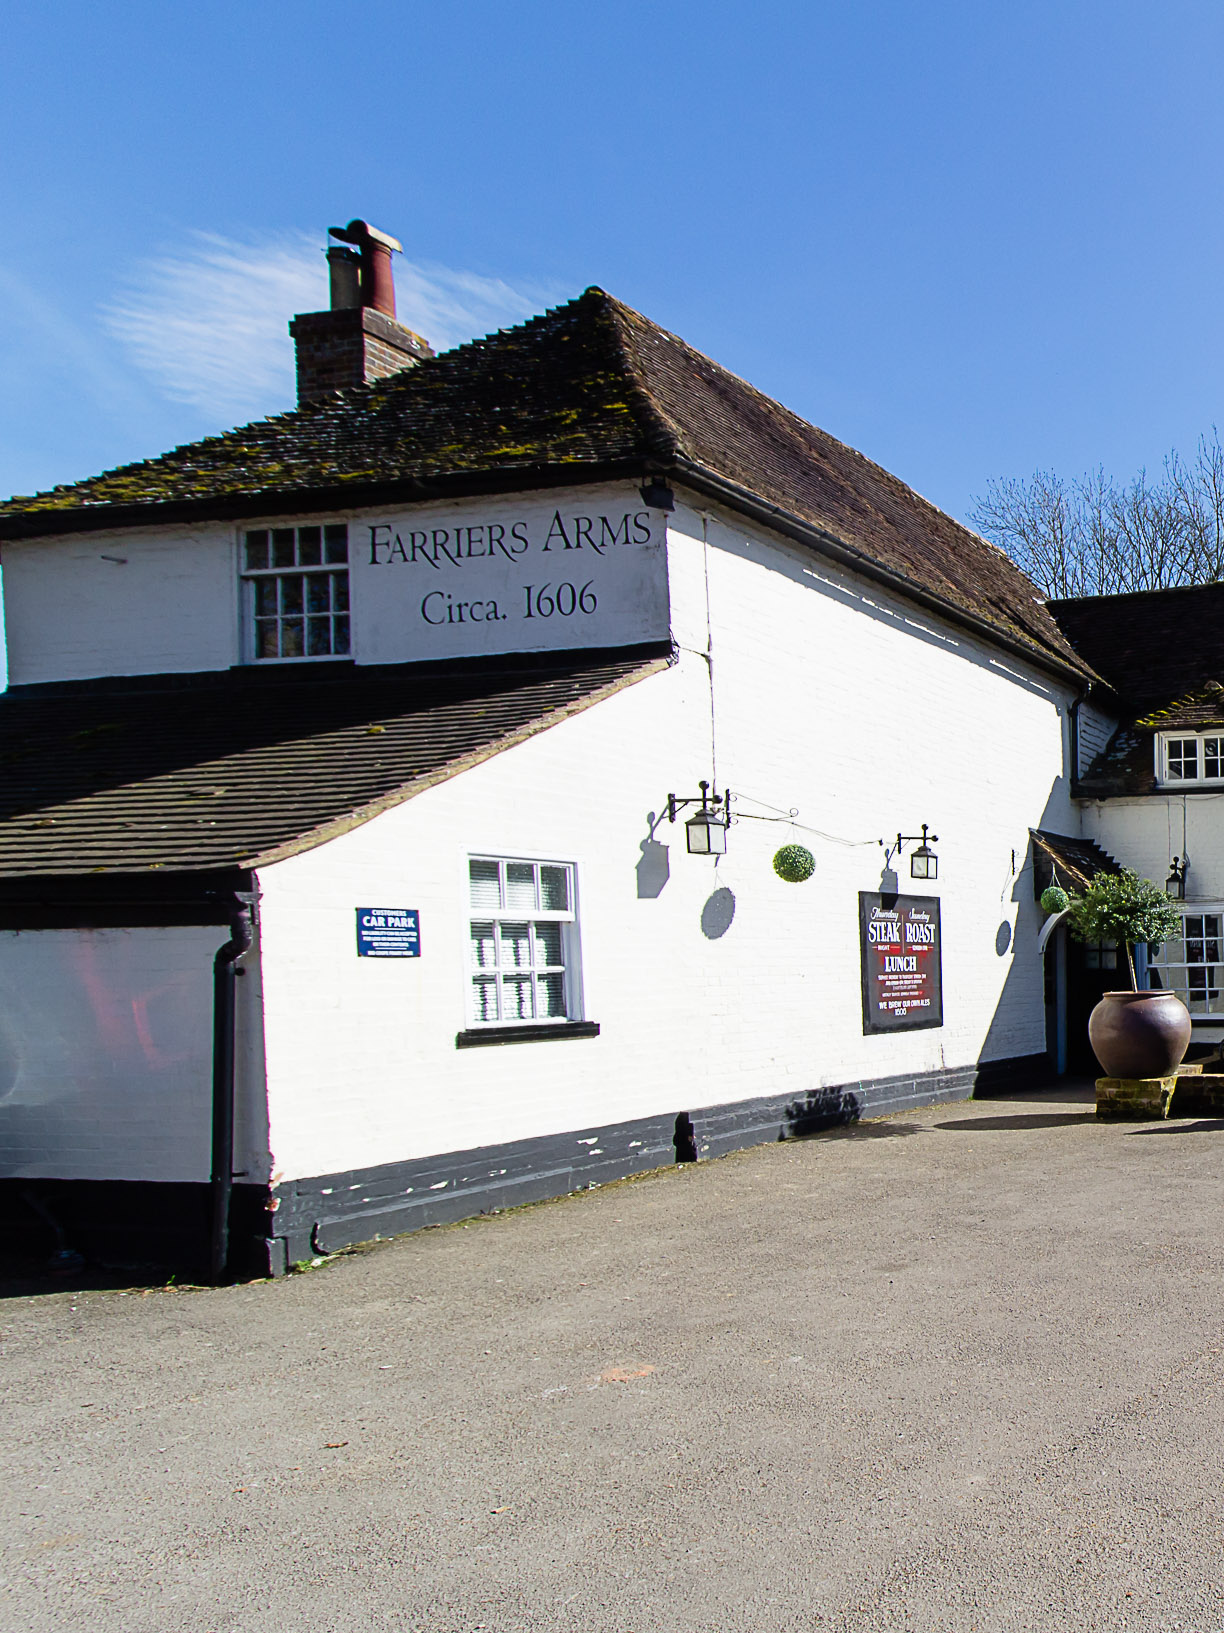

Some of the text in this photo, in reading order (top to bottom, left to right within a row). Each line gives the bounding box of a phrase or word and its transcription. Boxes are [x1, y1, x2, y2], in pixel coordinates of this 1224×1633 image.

[367, 510, 652, 569] FARRIERS ARMS
[420, 580, 598, 625] Circa. 1606
[362, 916, 416, 928] CAR PARK
[868, 921, 936, 943] STEAK ROAST
[884, 956, 917, 972] LUNCH
